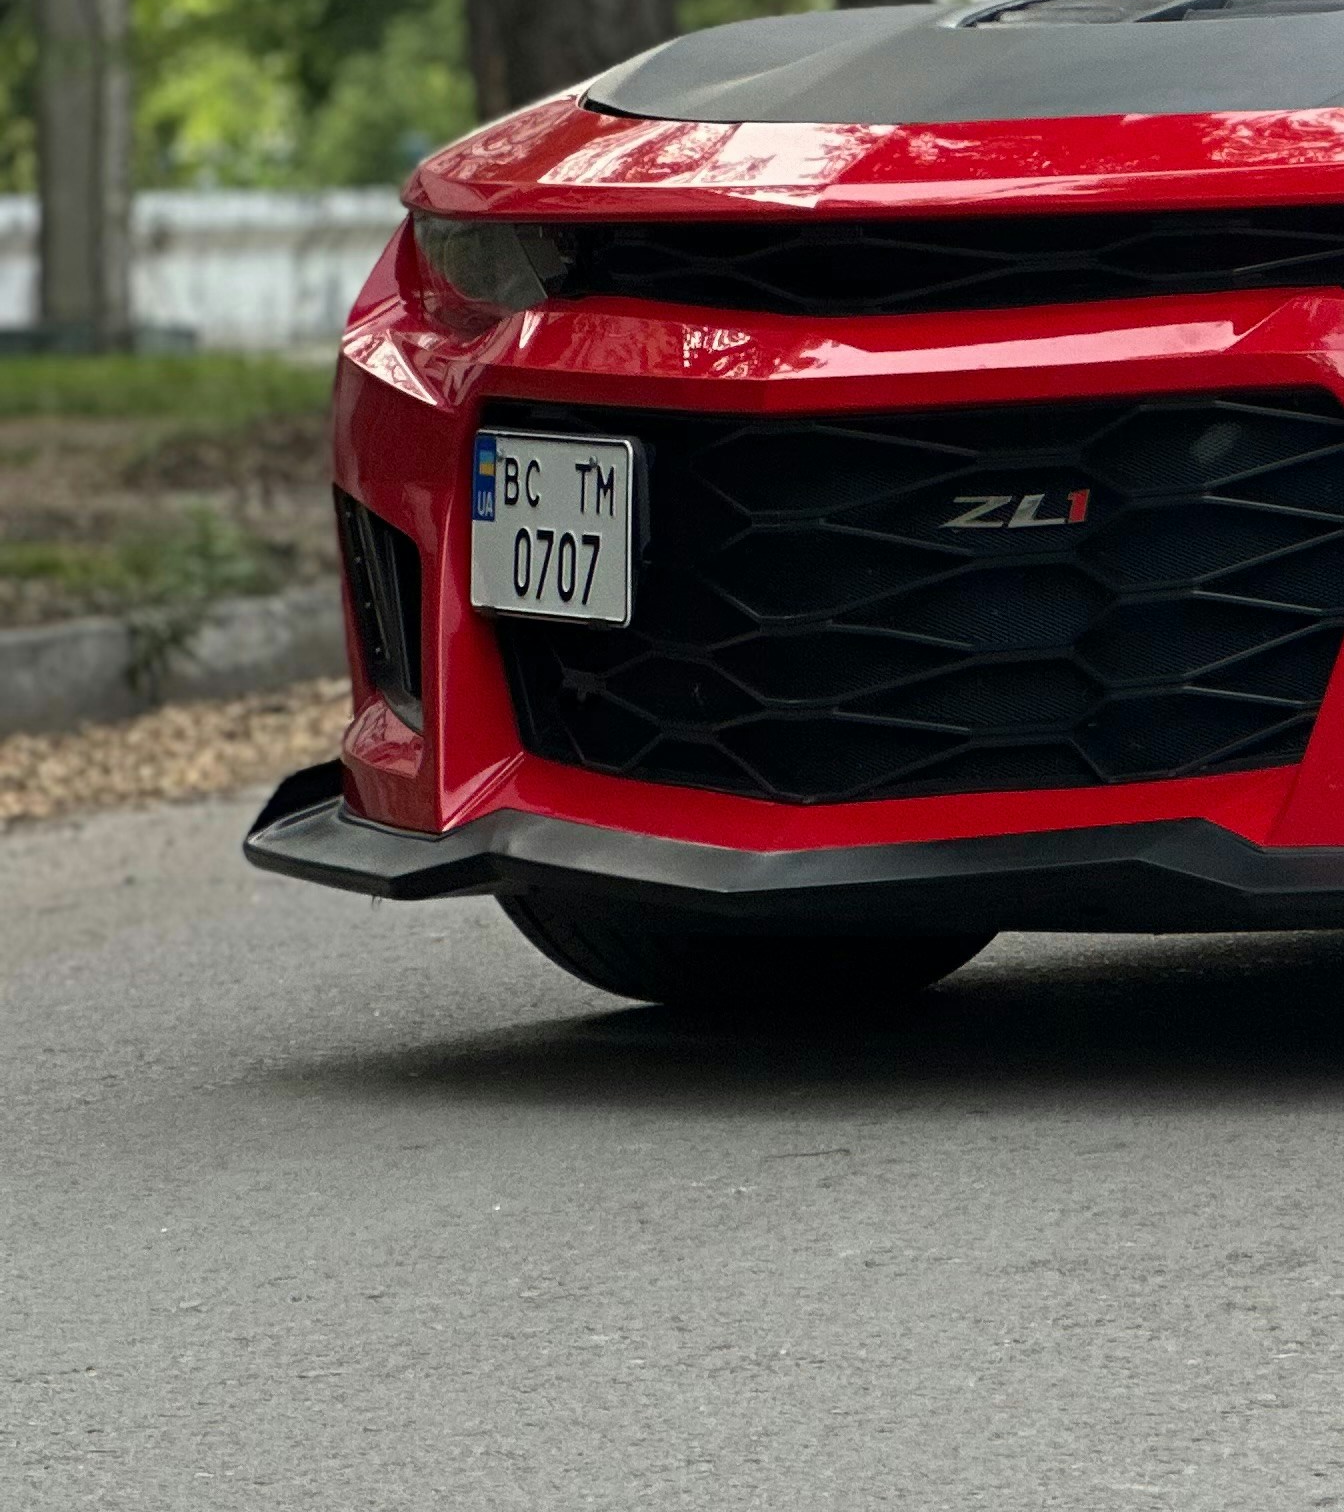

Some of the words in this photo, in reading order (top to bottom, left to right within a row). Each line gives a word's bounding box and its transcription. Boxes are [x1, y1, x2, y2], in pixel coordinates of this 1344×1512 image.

[477, 490, 494, 517] UA
[504, 457, 541, 508] BC
[575, 462, 615, 517] TM
[938, 489, 1090, 529] ZL1
[513, 527, 602, 606] 0707
